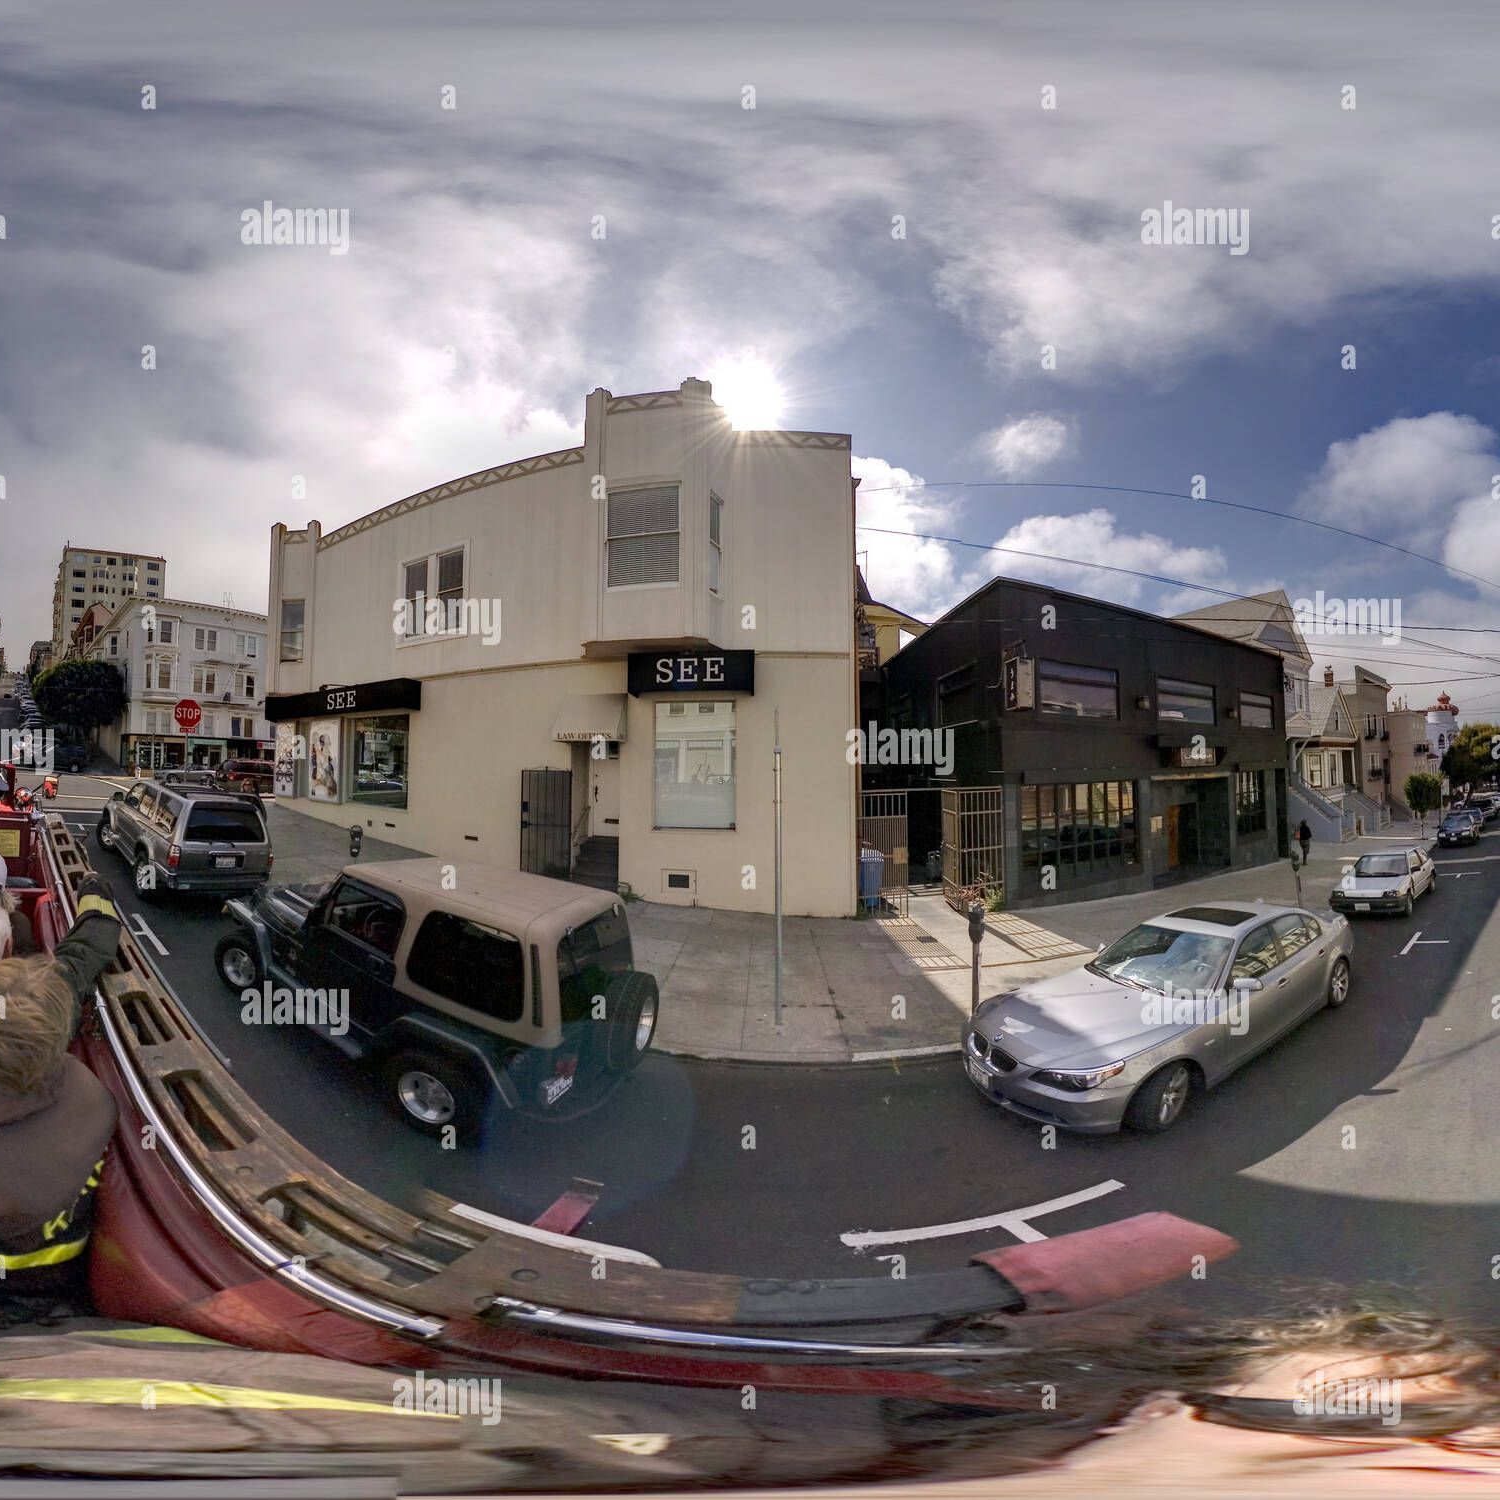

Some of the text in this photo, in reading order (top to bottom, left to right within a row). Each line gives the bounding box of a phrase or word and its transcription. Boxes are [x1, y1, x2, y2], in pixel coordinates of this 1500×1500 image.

[656, 657, 725, 683] SEE
[327, 690, 356, 710] SEE
[175, 707, 201, 719] STOP
[557, 732, 575, 740] LAW
